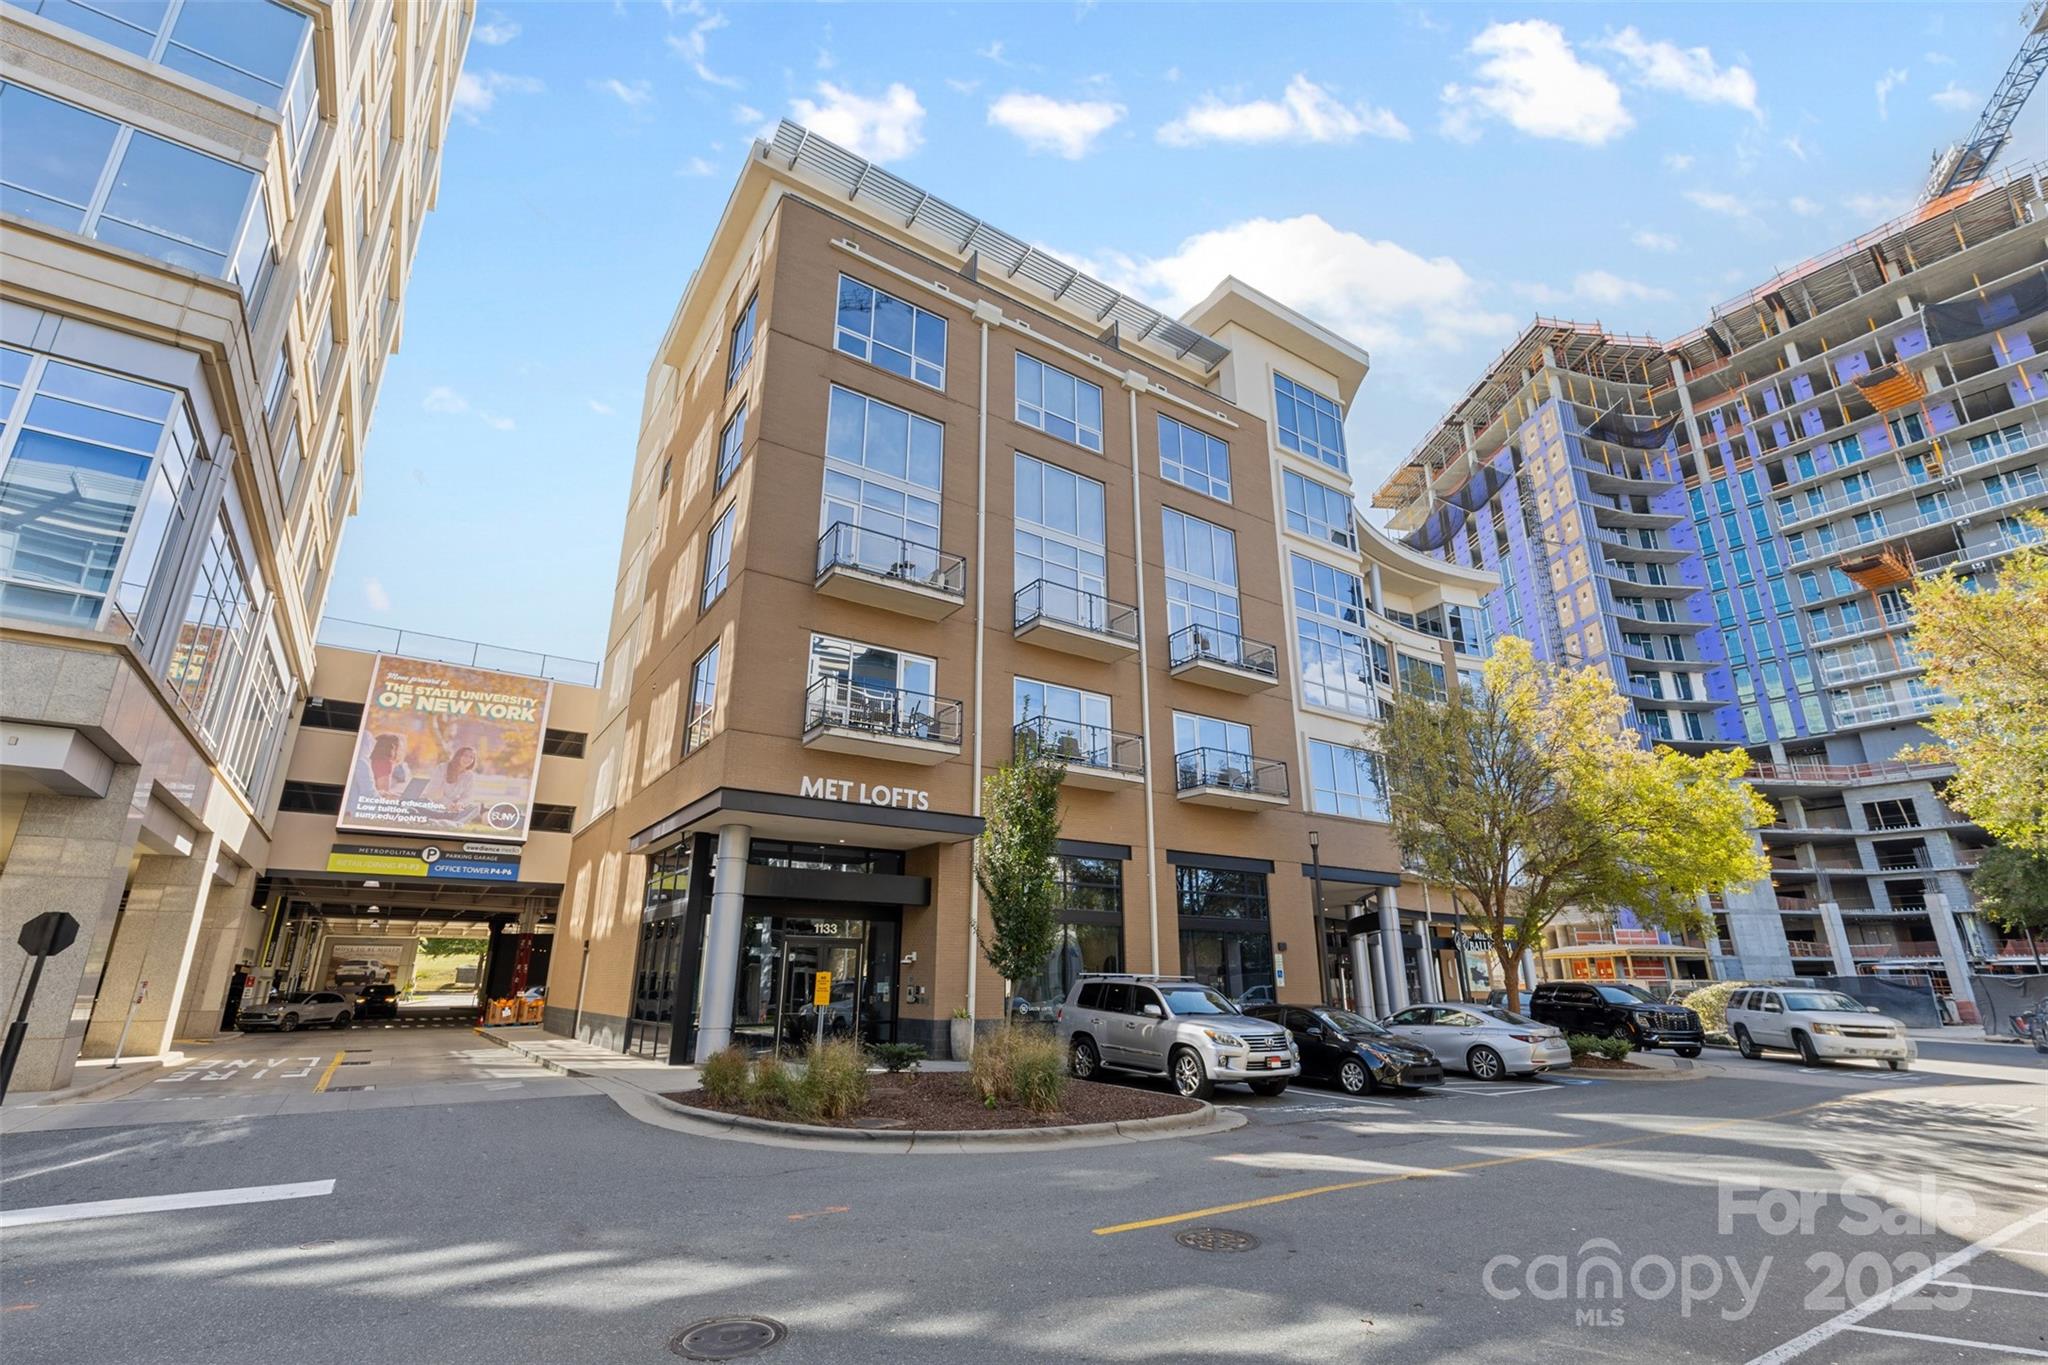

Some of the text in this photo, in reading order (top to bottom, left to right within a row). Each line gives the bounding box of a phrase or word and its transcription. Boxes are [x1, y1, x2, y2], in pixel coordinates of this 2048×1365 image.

[384, 682, 538, 707] THE STATE UNIVERSITY
[378, 691, 537, 723] OF NEW YORK
[800, 775, 929, 811] MET LOFTS
[356, 803, 410, 814] Low tuition.
[358, 795, 446, 810] Excellent education.
[354, 811, 428, 824] suny.edu/goNYS
[491, 811, 516, 821] SUNY
[358, 847, 417, 857] METROPOLITAN
[445, 852, 472, 861] PARKING
[434, 864, 461, 873] OFFICE
[462, 866, 490, 875] TOWER
[814, 923, 838, 934] 1133
[186, 1056, 321, 1069] LANE
[154, 1067, 313, 1082] FIRE
